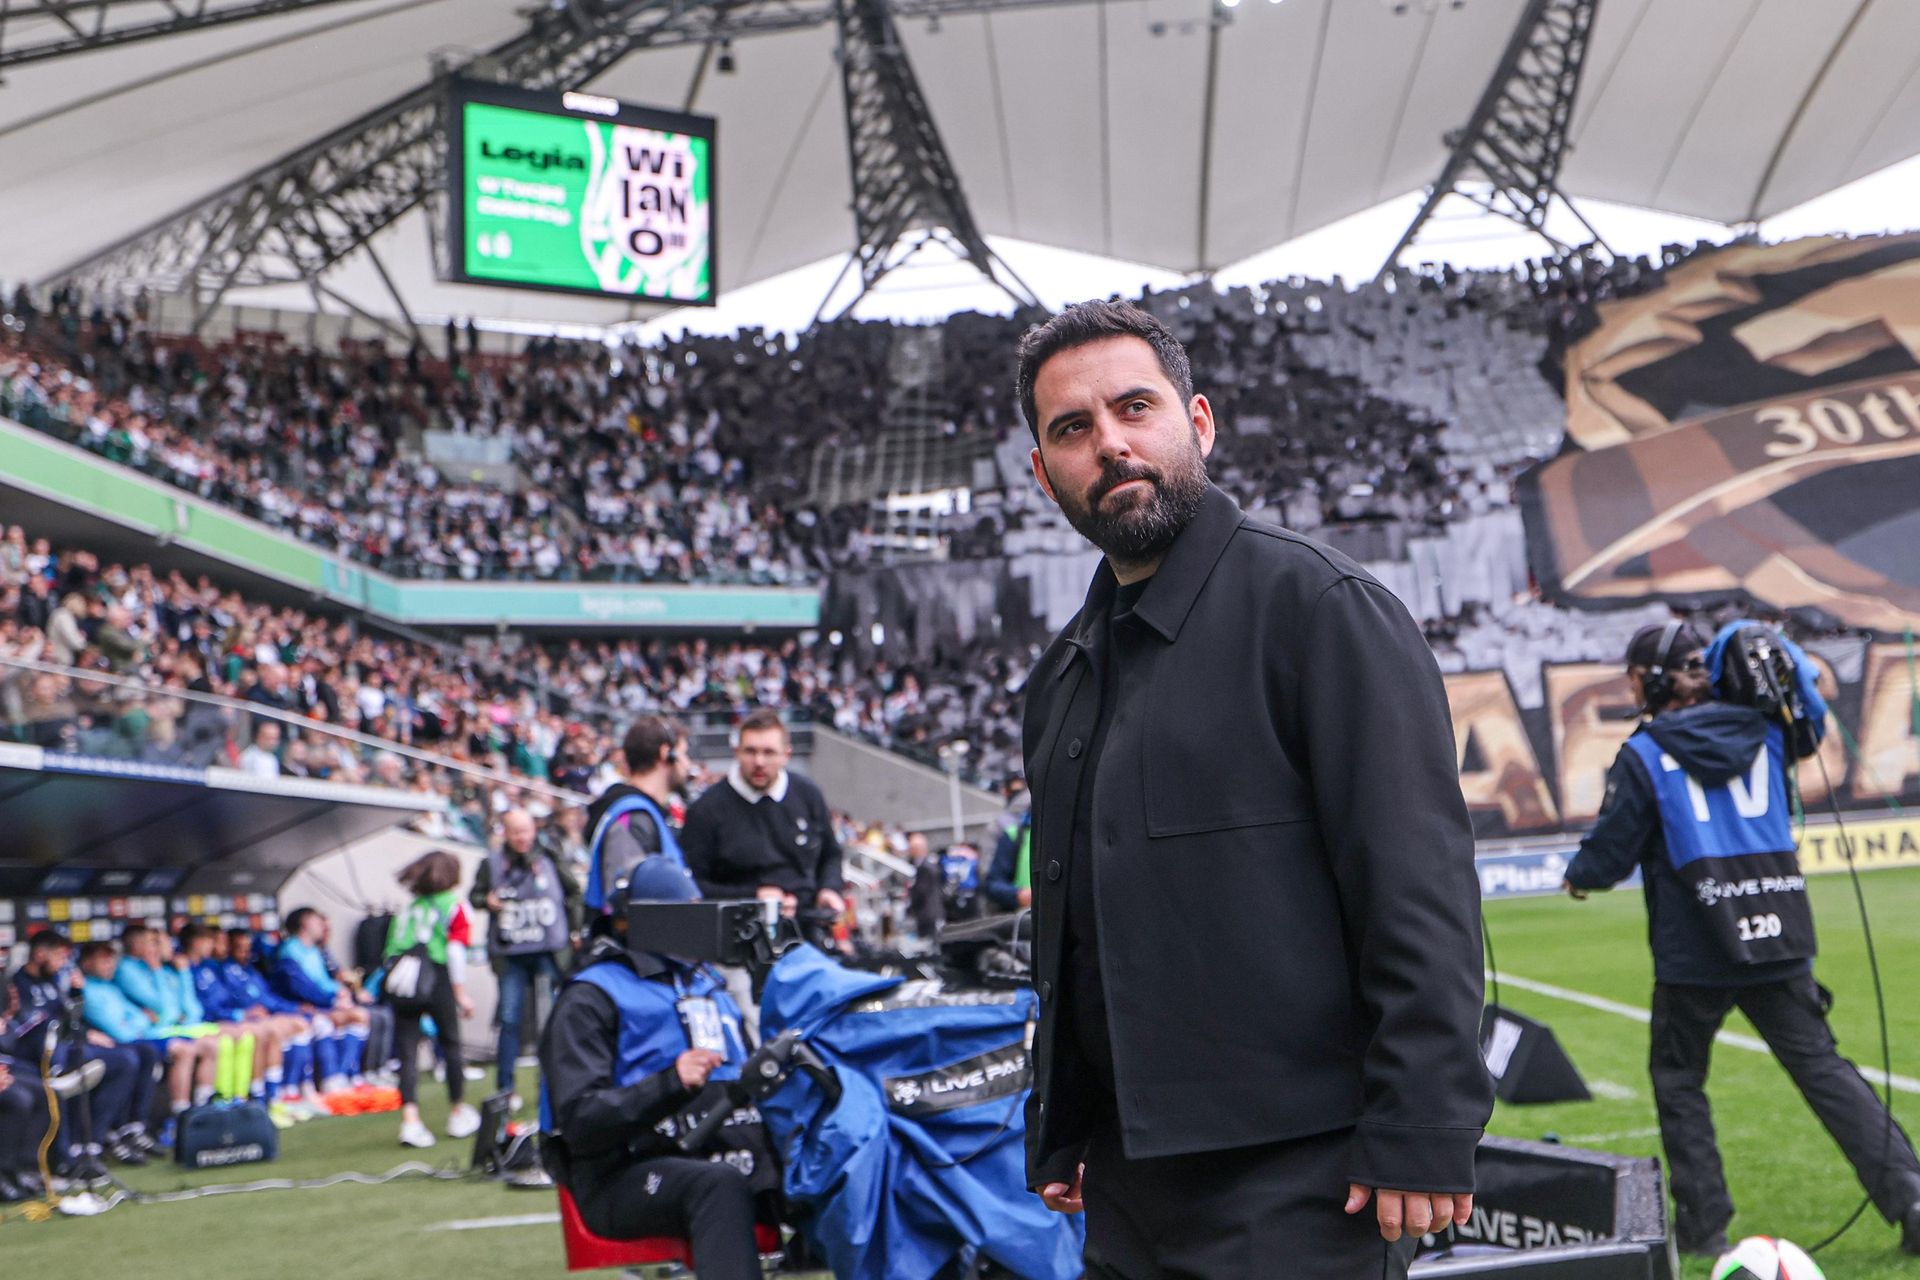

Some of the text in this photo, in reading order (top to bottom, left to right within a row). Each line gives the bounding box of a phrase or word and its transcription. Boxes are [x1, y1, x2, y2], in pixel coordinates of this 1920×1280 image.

[481, 139, 585, 171] Legia
[1483, 862, 1562, 893] Plus
[1737, 912, 1782, 942] 120
[929, 1070, 985, 1094] LIVE
